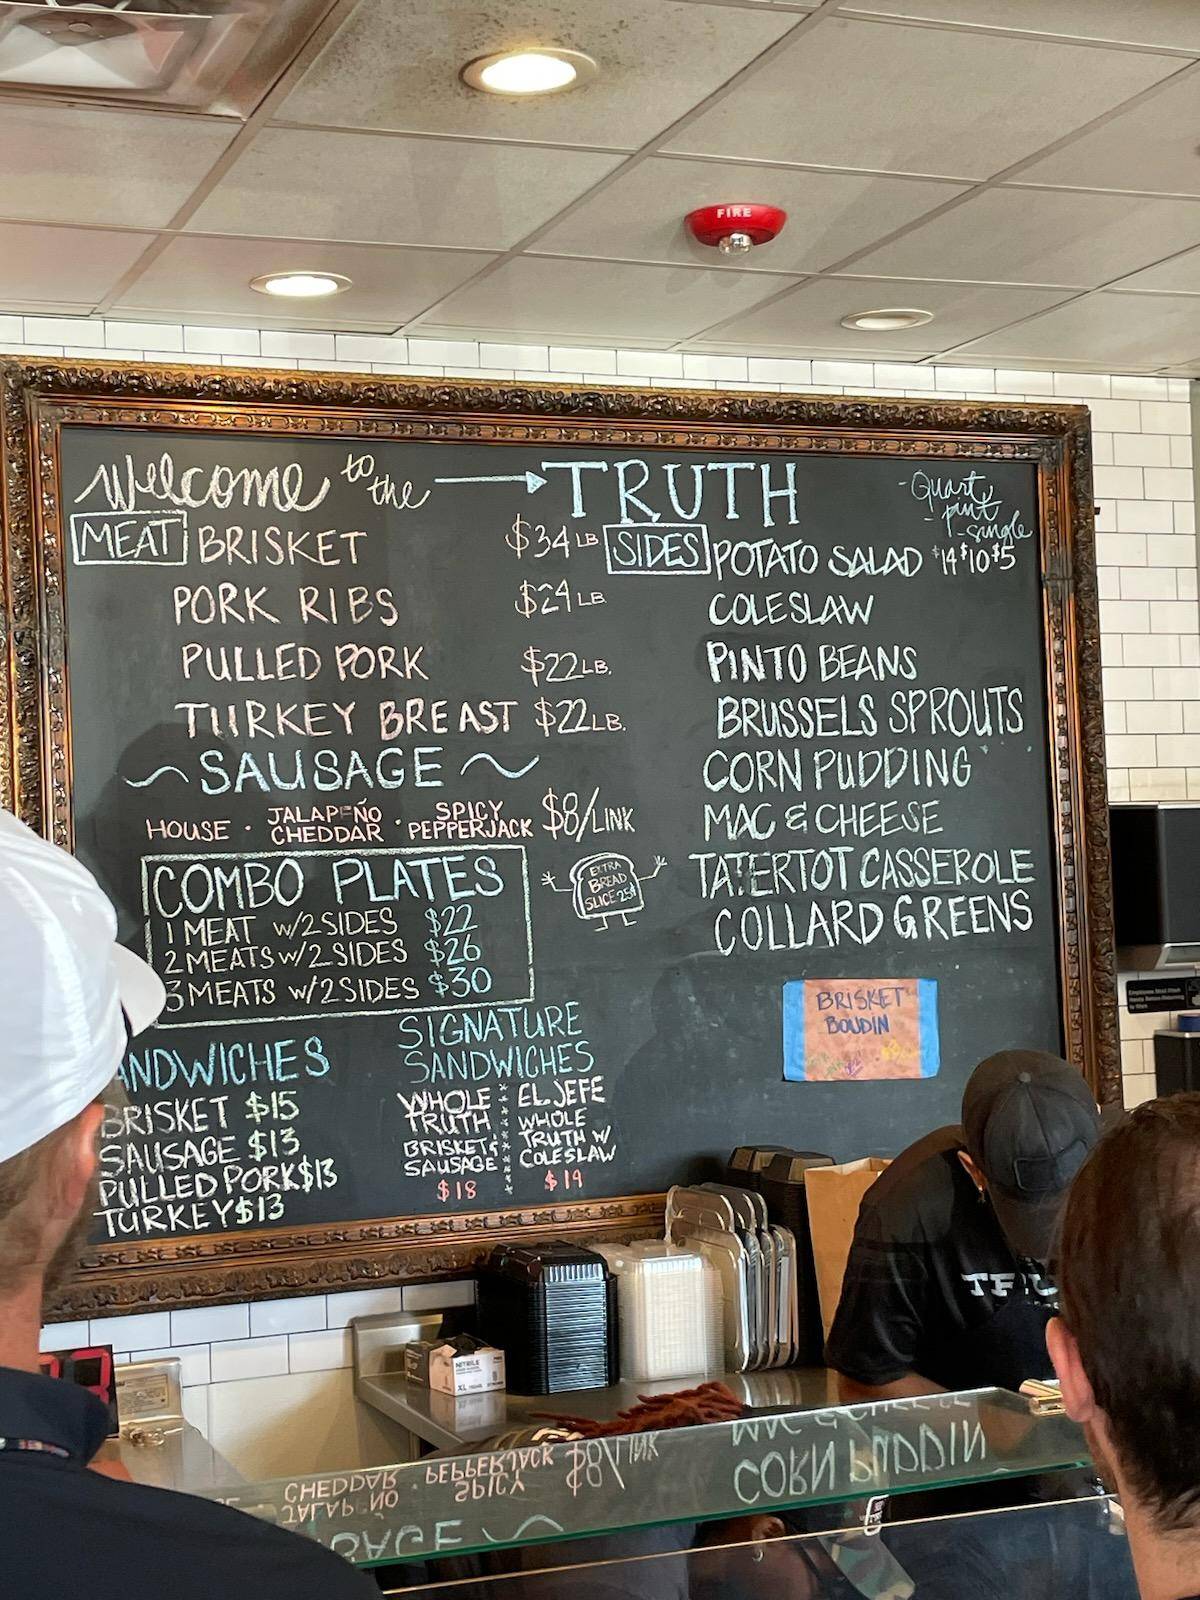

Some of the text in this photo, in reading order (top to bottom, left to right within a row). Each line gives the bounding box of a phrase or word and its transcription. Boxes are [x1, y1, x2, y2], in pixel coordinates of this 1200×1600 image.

[716, 207, 752, 219] FIRE
[74, 453, 801, 529] Welcome to the TRUTH
[80, 519, 174, 559] MEAT
[199, 527, 368, 567] BRISKET
[504, 513, 570, 560] $34
[612, 530, 700, 569] SIDES
[711, 539, 924, 582] POTATO SALAD
[931, 541, 1017, 576] $14 $10 $5
[172, 583, 400, 628] PORK RIBS
[514, 579, 572, 619] $24
[708, 591, 875, 627] COLESLAW
[182, 642, 430, 684] PULLED PORK
[520, 645, 585, 688] $22
[706, 640, 918, 684] PINTO BEANS
[174, 698, 519, 742] TURKEY BREAST
[533, 696, 592, 738] $22
[716, 685, 1025, 741] BRUSSELS SPROUTS
[199, 745, 445, 796] SAUSAGE
[702, 746, 972, 794] CORN PUDDING
[145, 819, 232, 843] HOUSE
[407, 817, 535, 842] PEPPERJACK
[434, 800, 505, 824] SPICY
[702, 801, 944, 842] MAC & CHEESE
[270, 823, 385, 846] CHEDDAR
[152, 854, 506, 919] COMBO PLATES
[587, 872, 628, 894] BREAD
[589, 860, 622, 877] EXTRA
[688, 846, 1037, 901] TATERTOT CASSEROLE
[584, 889, 617, 912] SLICE
[166, 920, 175, 945] 1
[183, 914, 257, 947] MEAT
[320, 906, 398, 937] SIDES
[423, 903, 479, 938] $22
[712, 888, 1034, 958] COLLARD GREENS
[163, 950, 184, 975] 2
[186, 944, 276, 975] MEATS
[332, 938, 408, 965] SIDES
[424, 936, 482, 967] $26
[164, 980, 185, 1013] 3
[187, 976, 276, 1008] MEATS
[333, 975, 421, 1004] SIDES
[427, 965, 493, 999] $30
[815, 985, 906, 1012] BRISKET
[397, 1001, 585, 1051] SIGNATURE
[824, 1013, 891, 1036] BOUDIN
[403, 1040, 596, 1085] SANDWICHES
[396, 1086, 493, 1115] WHOLE
[517, 1074, 607, 1109] EL JEFE
[100, 1089, 300, 1139] BRISKET $15
[403, 1110, 493, 1136] TRUTH
[517, 1106, 589, 1131] WHOLE
[99, 1126, 301, 1180] SAUSAGE $13
[402, 1137, 488, 1159] BRISKET
[517, 1128, 587, 1150] TRUTH
[518, 1144, 618, 1170] COLESLAW
[98, 1154, 339, 1210] PULLED PORK $13
[402, 1155, 500, 1178] SAUSAGE
[543, 1168, 584, 1193] $19
[436, 1178, 479, 1204] $18
[92, 1192, 286, 1239] TURKEY $13
